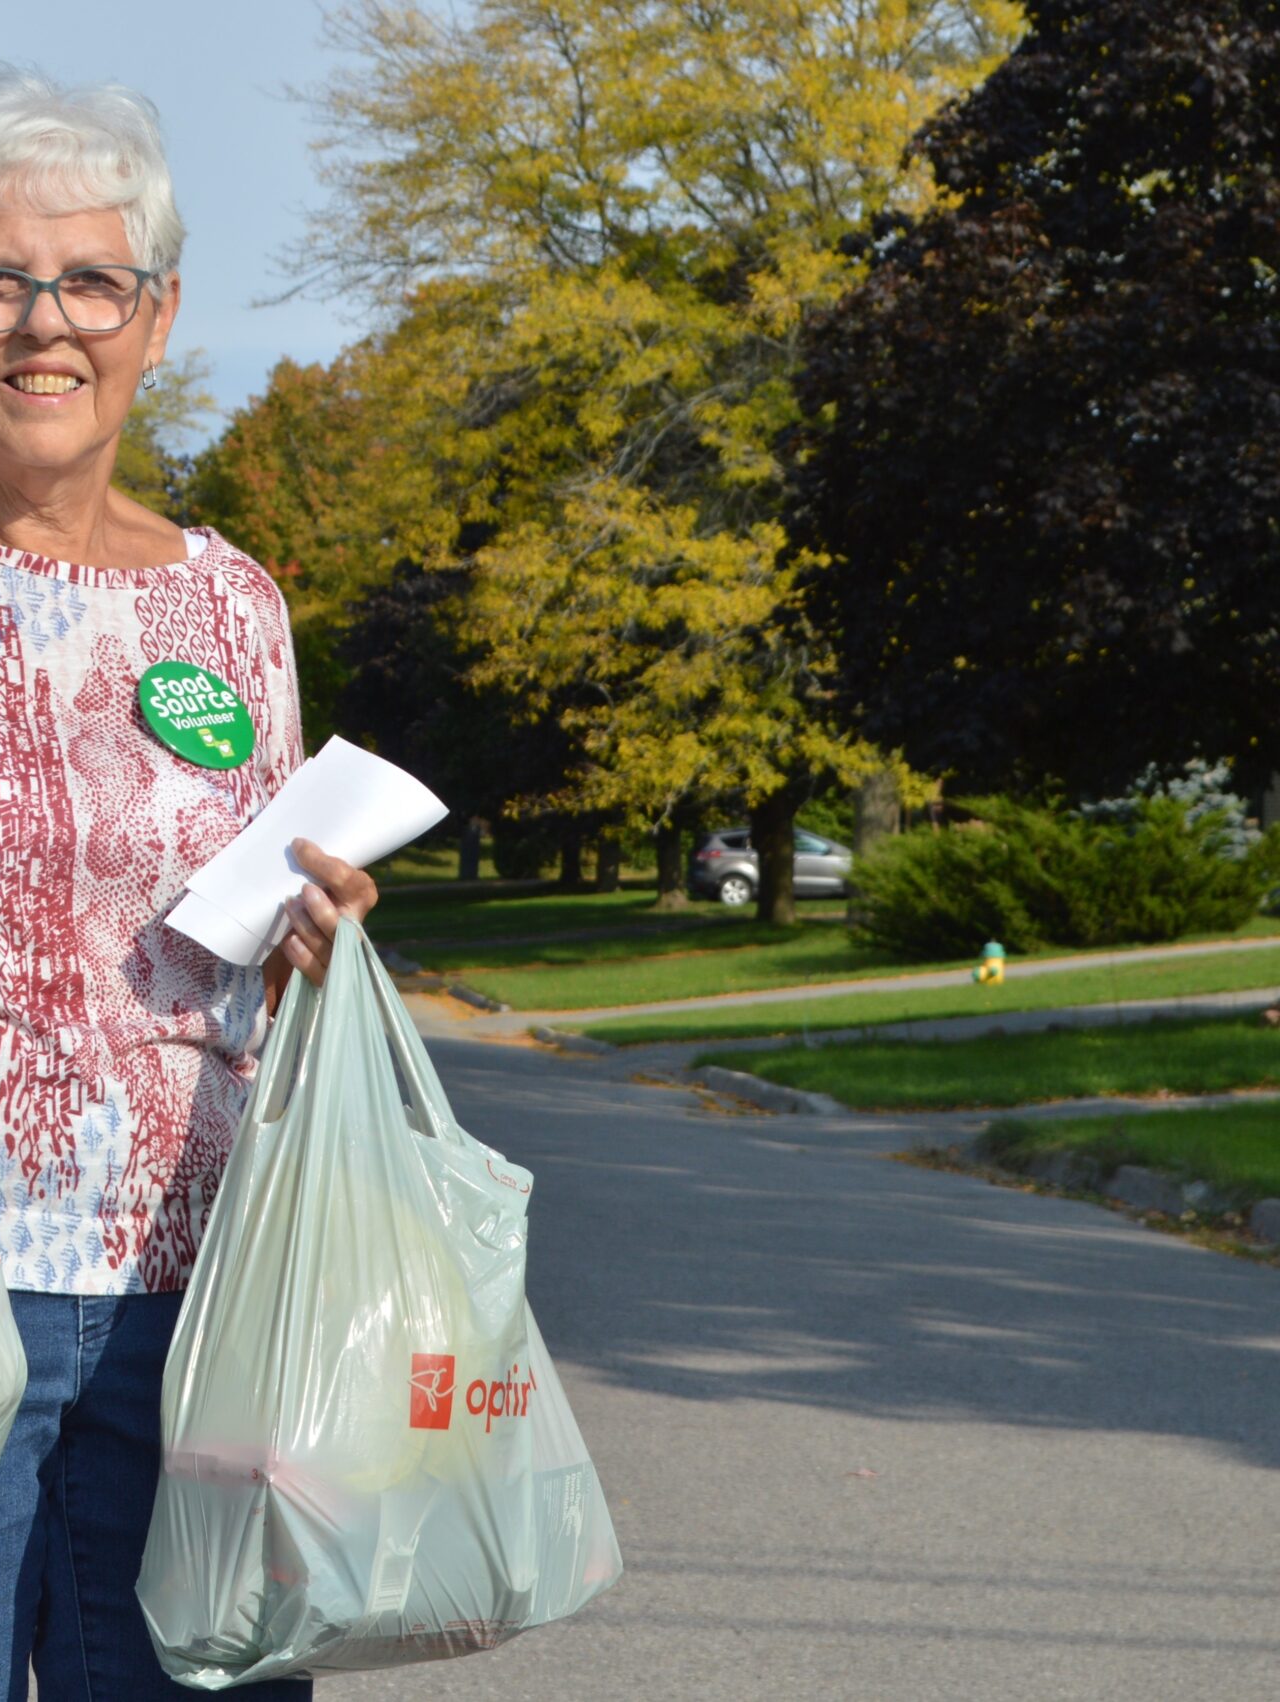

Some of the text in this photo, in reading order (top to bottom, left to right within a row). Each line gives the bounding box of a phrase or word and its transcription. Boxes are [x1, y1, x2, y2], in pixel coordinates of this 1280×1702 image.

[150, 671, 213, 698] Food
[150, 691, 238, 717] Source
[169, 712, 236, 730] Volunteer
